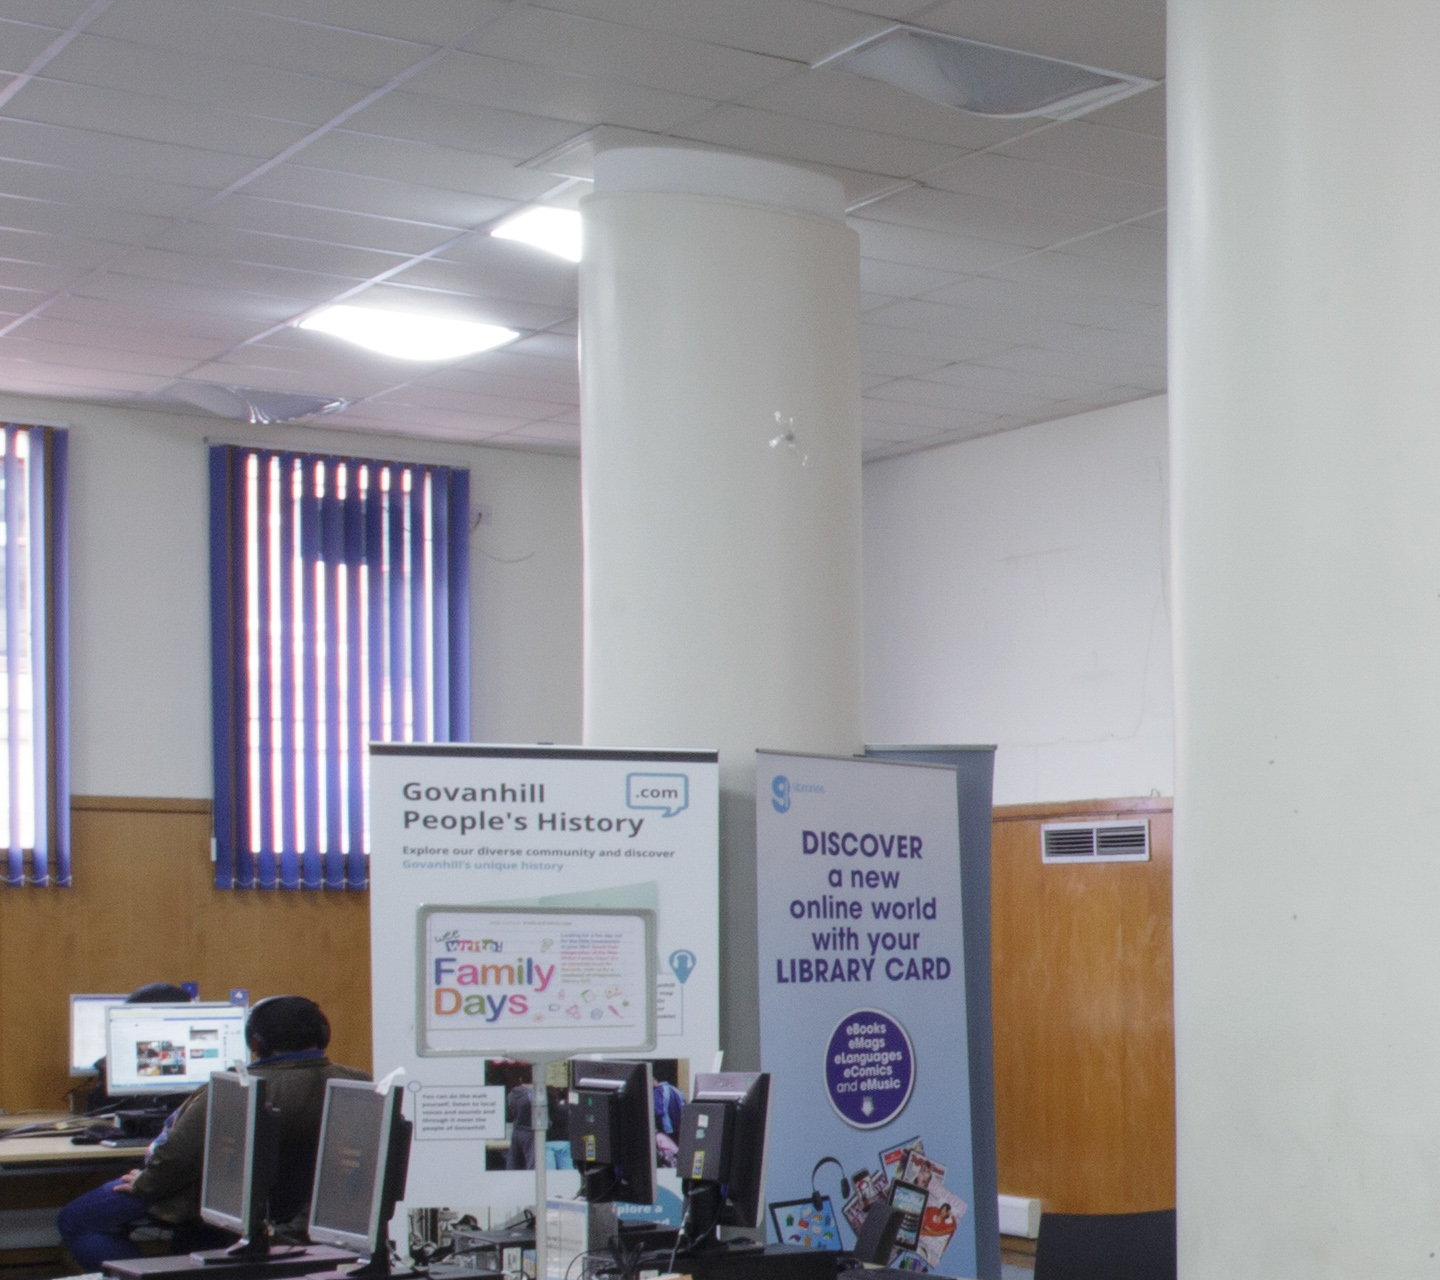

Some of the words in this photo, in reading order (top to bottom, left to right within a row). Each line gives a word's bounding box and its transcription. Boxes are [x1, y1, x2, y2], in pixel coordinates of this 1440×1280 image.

[402, 781, 546, 803] Govanhill
[635, 786, 679, 799] .com
[403, 810, 528, 836] People's
[537, 812, 645, 838] History
[402, 845, 449, 858] Explore
[453, 848, 474, 857] our
[477, 846, 523, 858] diverse
[526, 847, 596, 860] community
[599, 847, 621, 858] and
[623, 848, 676, 859] discover
[802, 830, 923, 860] DISCOVER
[474, 860, 518, 873] unique
[521, 860, 565, 873] history
[828, 868, 842, 888] a
[851, 869, 900, 889] new
[790, 894, 863, 919] online
[871, 896, 937, 920] world
[811, 926, 859, 951] with
[867, 931, 921, 956] your
[434, 957, 555, 992] Family
[776, 957, 875, 983] LIBRARY
[885, 957, 951, 981] CARD
[434, 987, 528, 1024] Days
[845, 1022, 887, 1036] eBooks
[848, 1036, 886, 1051] eMags
[834, 1050, 903, 1066] eLanguages
[843, 1065, 893, 1079] eComics
[836, 1080, 858, 1093] and
[860, 1077, 901, 1091] eMusic
